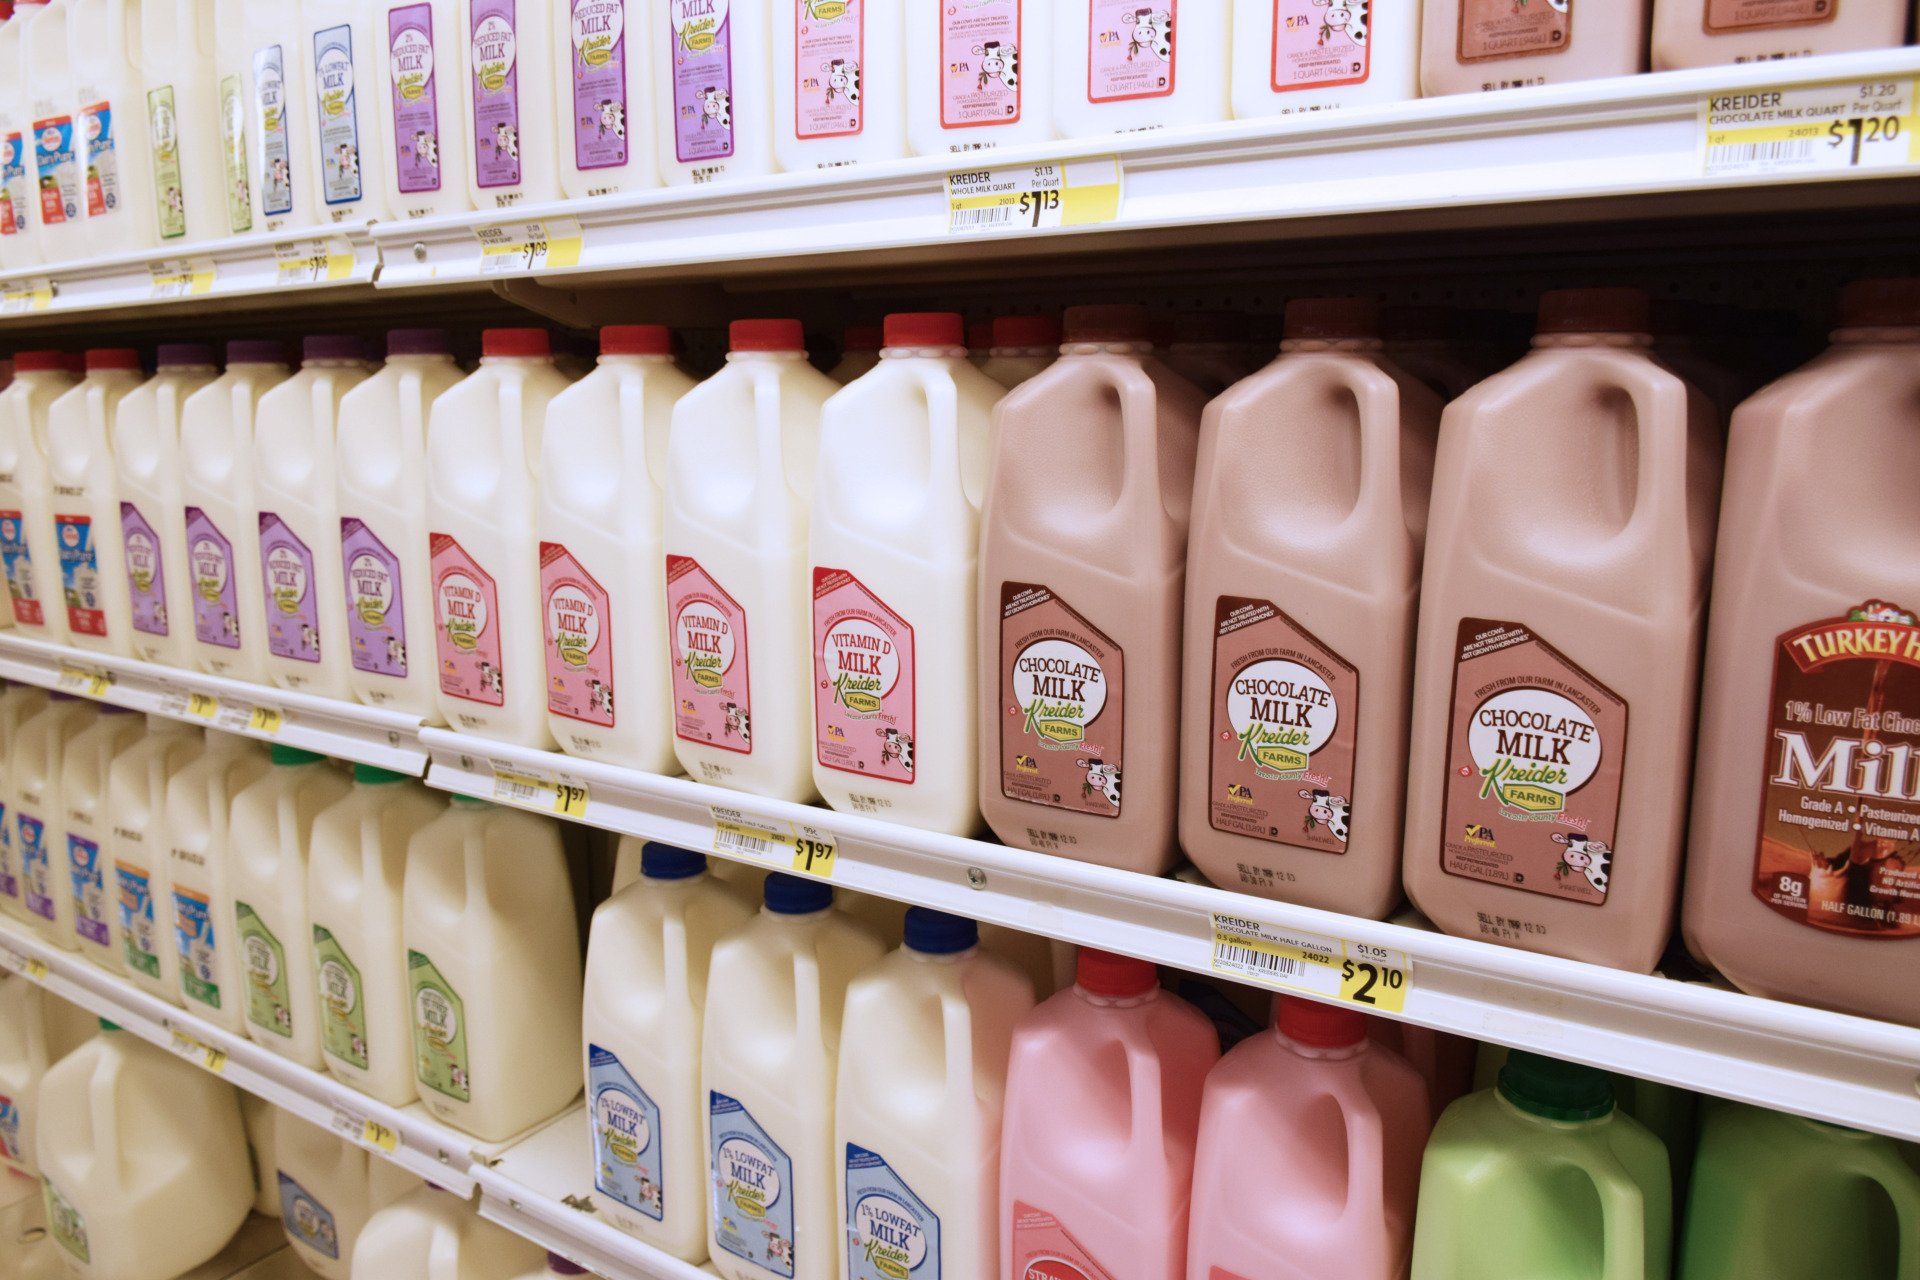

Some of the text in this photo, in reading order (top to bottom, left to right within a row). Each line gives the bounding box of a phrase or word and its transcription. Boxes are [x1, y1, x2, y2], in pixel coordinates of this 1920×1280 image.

[606, 3, 619, 14] FAT
[1296, 14, 1309, 26] PA
[581, 14, 611, 36] MILK
[398, 54, 423, 72] MILK
[480, 43, 505, 61] MILK
[1709, 84, 1897, 112] KREIDER $1.20
[1709, 100, 1902, 125] CHOCOLATE MILK QUART Per Quart
[949, 165, 1053, 186] KREIDER $1.13
[951, 177, 1060, 196] WHOLE MILK QUART Per Quart
[357, 579, 383, 597] MILK
[443, 585, 474, 600] VITAMIN
[447, 599, 476, 620] MILK
[553, 598, 594, 617] VITAMIN D
[557, 612, 588, 635] MILK
[682, 615, 729, 636] VITAMIN D
[1474, 626, 1506, 641] OUR COWS
[687, 630, 722, 655] MILK
[831, 633, 892, 655] VITAMIN D
[1014, 635, 1029, 650] FRESH
[1029, 630, 1043, 641] FROM
[1043, 628, 1055, 636] OUR
[1055, 628, 1070, 638] FARM
[1076, 634, 1105, 660] LANCASTER
[1463, 628, 1524, 652] ARE NOT TREATED WITH
[1792, 627, 1907, 663] TURKEY
[684, 651, 722, 685] Kreider
[837, 650, 882, 677] MILK
[1019, 657, 1101, 684] CHOCOLATE
[1230, 647, 1336, 683] FRESH FROM OUR FARM IN LANCASTER
[697, 673, 719, 684] FARMS
[832, 672, 882, 709] Kreider
[1032, 674, 1086, 702] MILK
[849, 696, 877, 708] FARMS
[1235, 678, 1331, 708] CHOCOLATE
[1474, 675, 1602, 716] FRESH FROM OUR FARM IN LANCASTER
[1023, 698, 1085, 739] Kreider
[1249, 697, 1313, 728] MILK
[1785, 700, 1813, 724] 1%
[1814, 703, 1852, 728] Low
[1852, 706, 1881, 731] Fat
[1044, 724, 1079, 736] FARMS
[1479, 709, 1595, 744] CHOCOLATE
[1238, 722, 1311, 767] Kreider
[1495, 729, 1573, 766] MILK
[1025, 756, 1038, 769] PA
[1262, 751, 1302, 765] FARMS
[1239, 786, 1253, 799] PA
[1479, 758, 1568, 806] Kreider
[1509, 789, 1557, 806] FARMS
[1800, 795, 1833, 814] Grade
[1834, 801, 1844, 815] A
[711, 806, 742, 818] KREIDER
[1478, 826, 1496, 841] PA
[1778, 808, 1920, 842] Homogenized Vitamin A
[1449, 860, 1467, 873] HALF
[1467, 863, 1485, 876] GAL
[1779, 875, 1804, 897] 8g
[1821, 900, 1884, 920] HALF GALLON
[1214, 914, 1388, 958] KREIDER $1.05
[1215, 923, 1260, 938] CHOCOLATE
[1261, 932, 1279, 943] MILK
[1280, 936, 1299, 946] HALF
[1301, 941, 1333, 954] GALLON
[1216, 933, 1330, 964] 0.5 gallons 24022
[607, 1111, 638, 1138] MILK
[734, 1149, 776, 1177] LOWFAT
[730, 1162, 766, 1190] MILK
[726, 1179, 766, 1206] Kreider
[861, 1203, 922, 1238] 1% LOWFAT
[869, 1219, 911, 1252] MILK
[863, 1238, 910, 1268] Kreider
